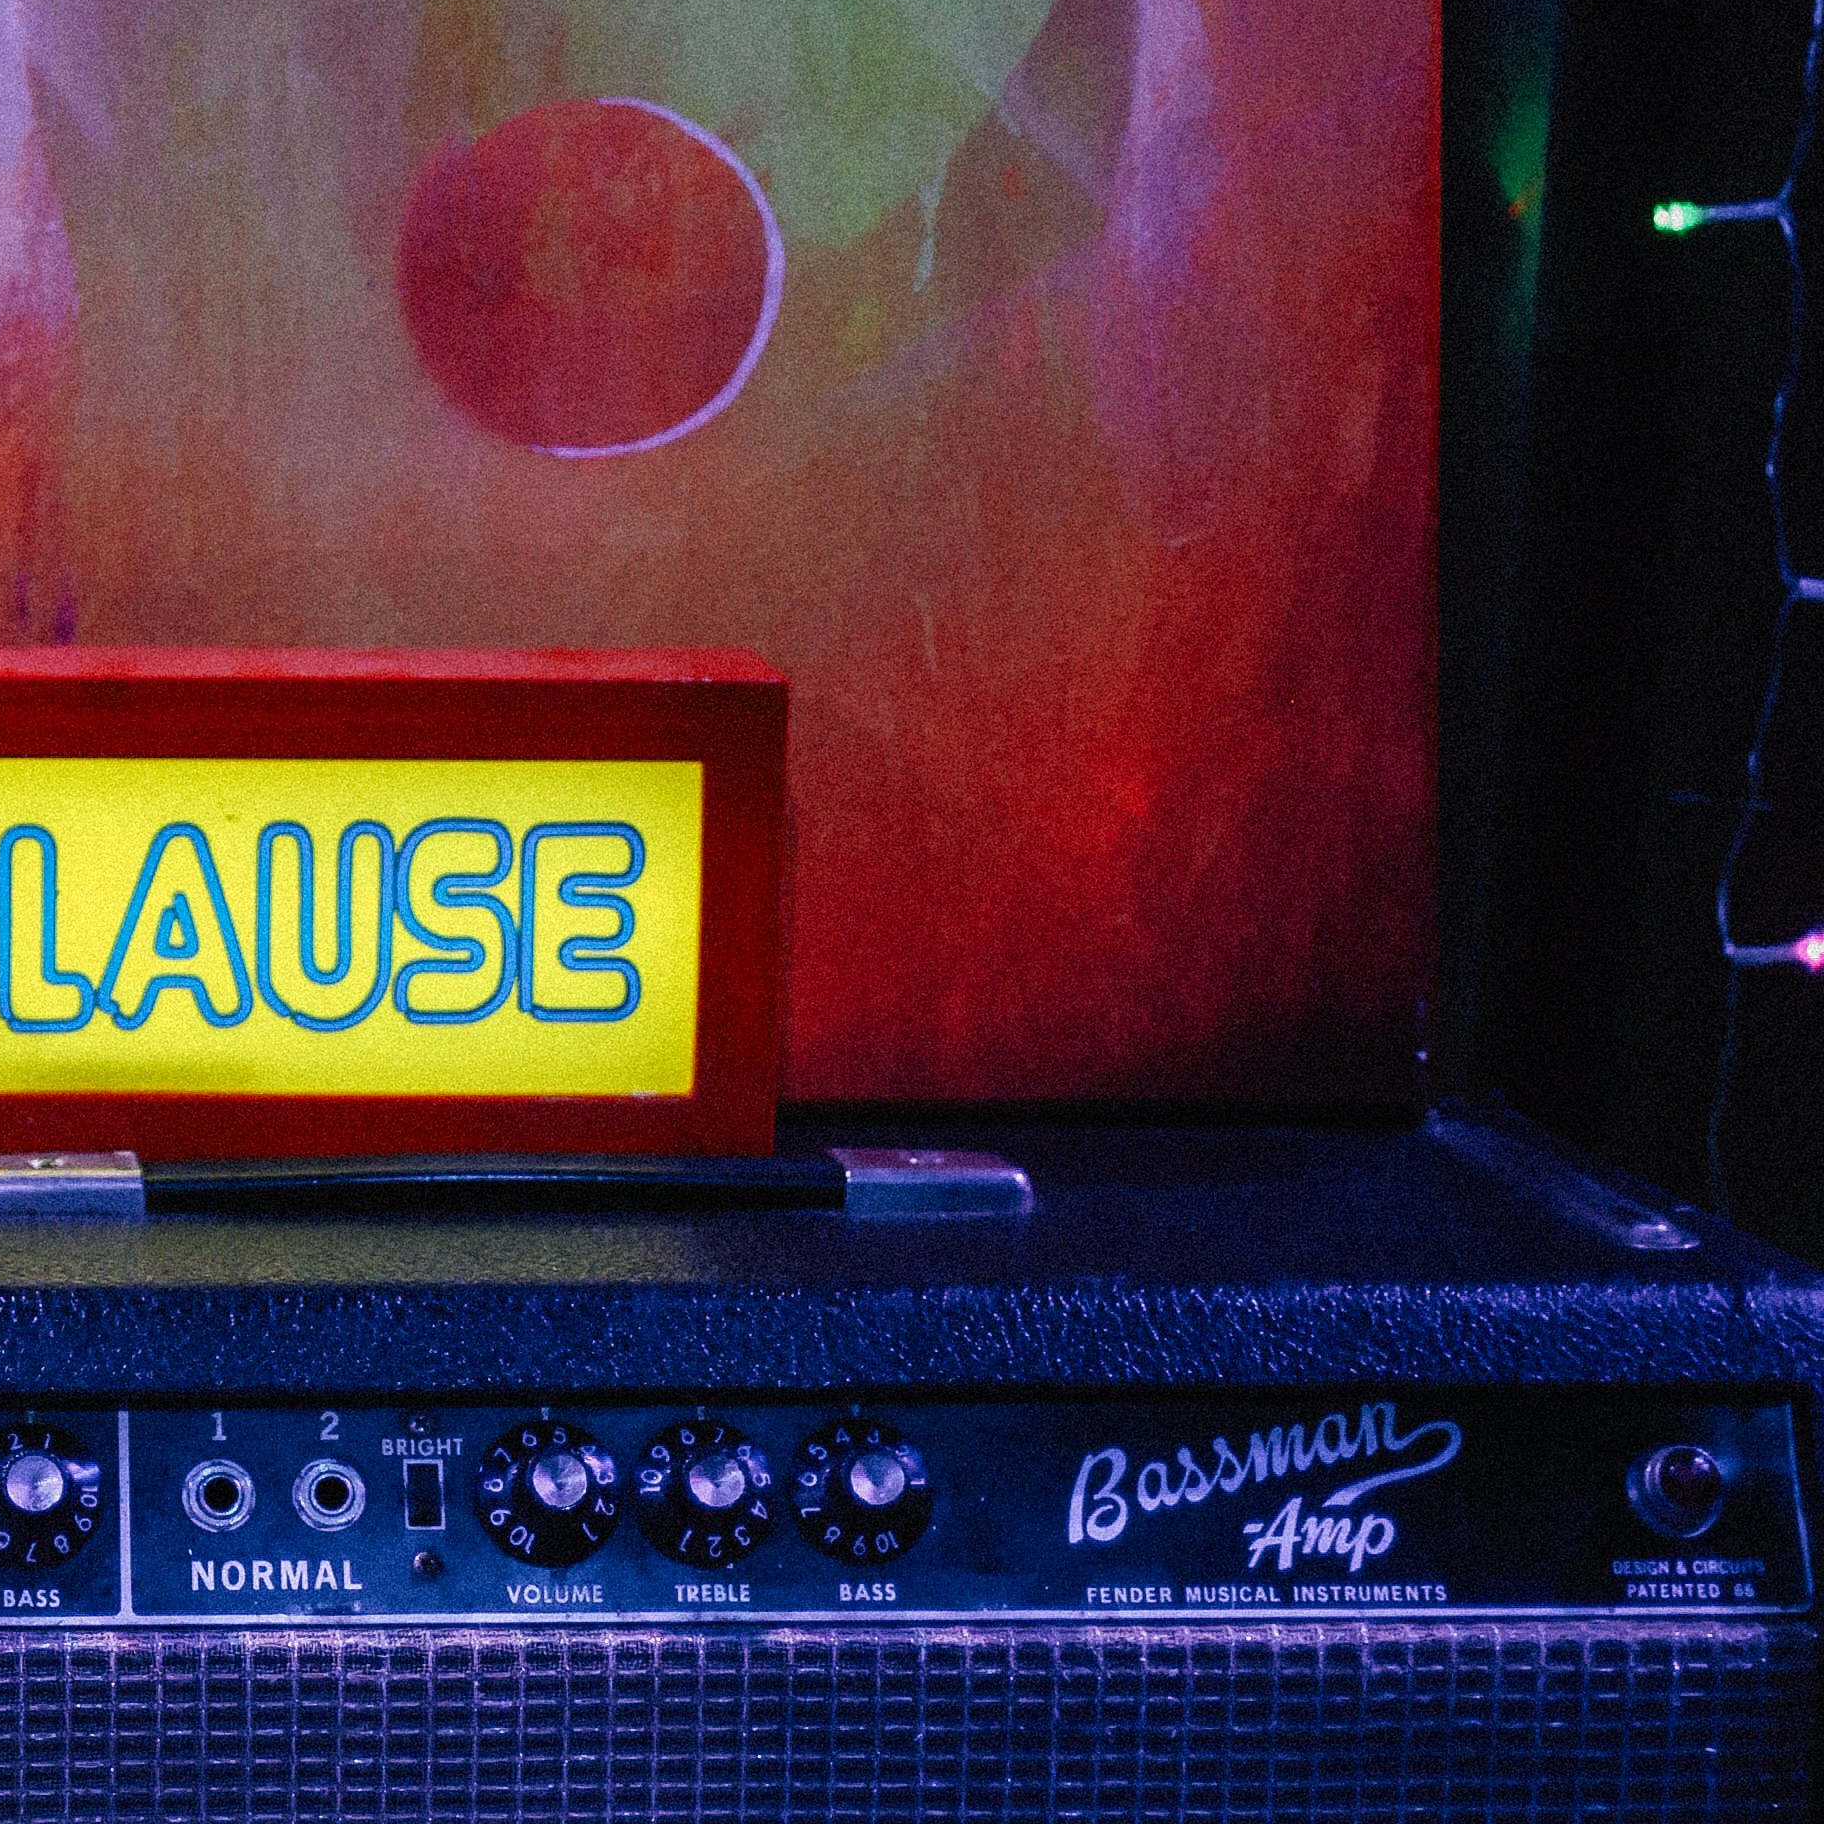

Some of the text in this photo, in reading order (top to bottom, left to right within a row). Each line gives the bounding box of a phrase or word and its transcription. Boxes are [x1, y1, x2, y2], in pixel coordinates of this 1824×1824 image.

[211, 1410, 340, 1441] 1 2
[7, 1433, 23, 1451] 2
[381, 1437, 464, 1456] BRIGHT
[1068, 1399, 1464, 1544] Bassman
[190, 1559, 363, 1591] NORMAL
[1612, 1559, 1670, 1575] DESIGN
[1676, 1559, 1687, 1575] &
[3, 1589, 62, 1609] BASS
[506, 1584, 604, 1604] VOLUME
[674, 1584, 752, 1603] TREBLE
[839, 1584, 897, 1603] BASS
[1086, 1585, 1448, 1604] FENDER MUSICAL INSTRUMENTS
[1627, 1583, 1721, 1599] PATENTED
